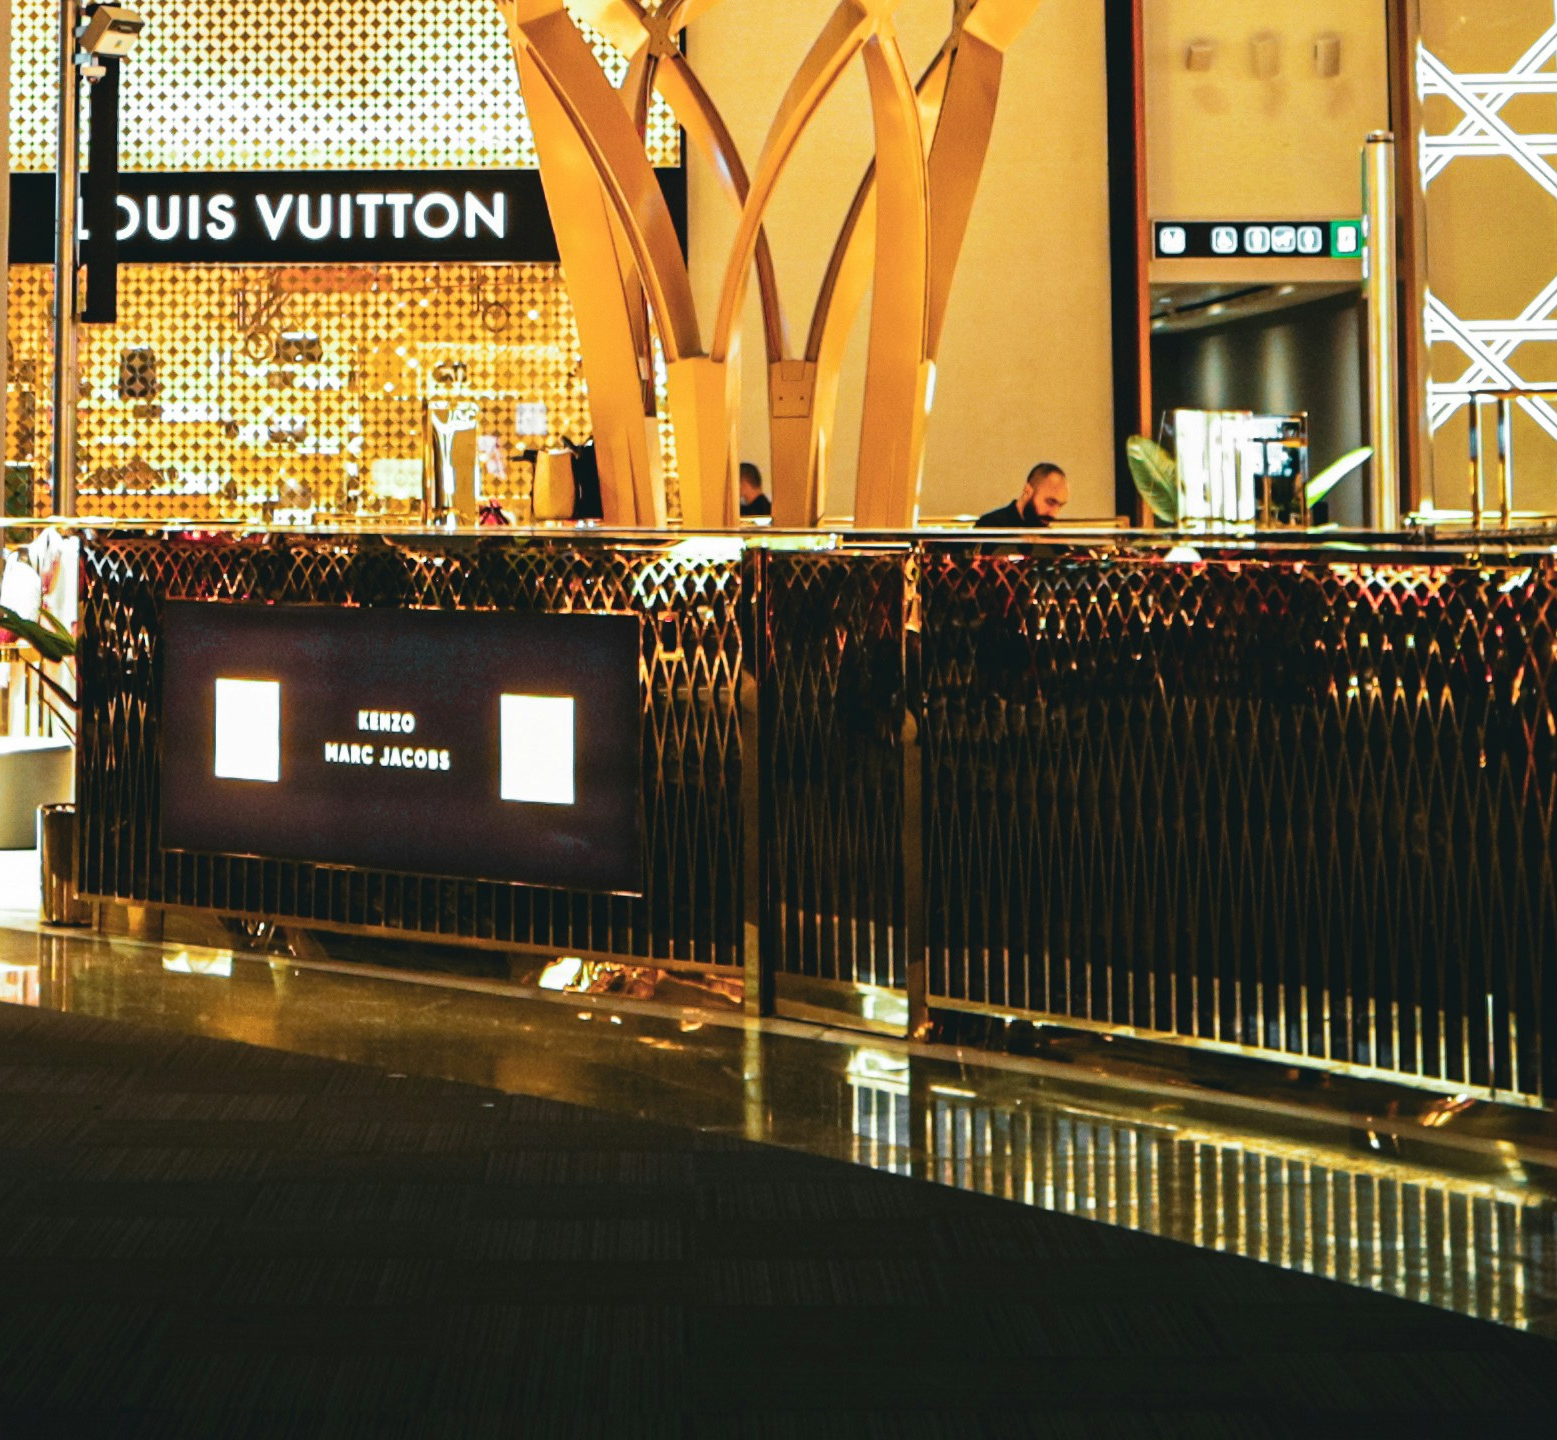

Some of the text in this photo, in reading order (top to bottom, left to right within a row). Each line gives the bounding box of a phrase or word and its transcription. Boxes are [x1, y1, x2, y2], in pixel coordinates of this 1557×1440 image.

[255, 191, 506, 241] VUITTON
[357, 709, 416, 734] KENZO
[324, 741, 451, 771] MARC JACOBS
